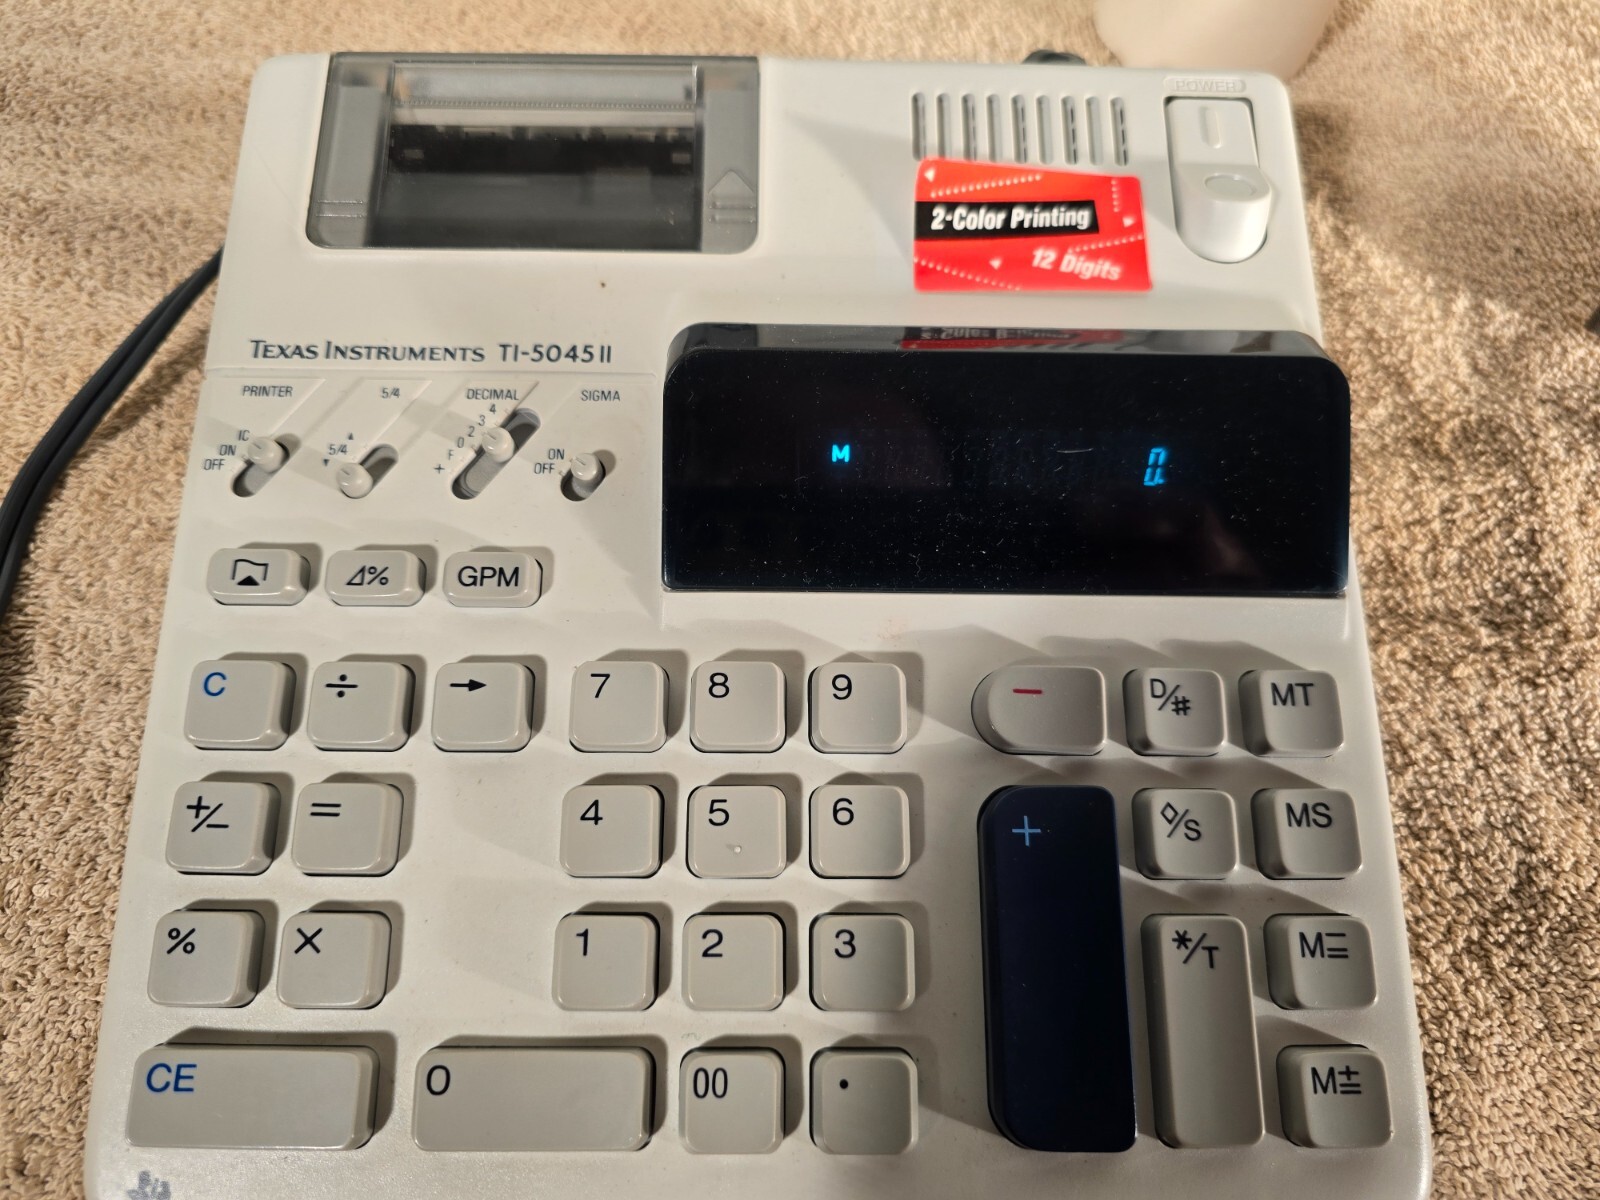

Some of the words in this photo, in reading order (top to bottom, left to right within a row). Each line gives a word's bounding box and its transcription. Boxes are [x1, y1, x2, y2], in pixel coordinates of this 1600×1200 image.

[1174, 79, 1237, 93] POWER
[930, 207, 1006, 231] 2-Color
[1009, 205, 1092, 230] Printing
[1031, 248, 1056, 269] 12
[1059, 251, 1122, 281] Digits
[242, 385, 293, 398] PRINTER
[381, 387, 401, 399] 5/4
[466, 388, 520, 401] DECIMAL
[581, 389, 621, 402] SIGMA
[479, 415, 487, 426] 3
[489, 404, 497, 415] 4
[238, 429, 251, 442] IC
[468, 426, 476, 437] 2
[219, 444, 237, 457] ON
[328, 443, 349, 456] 5/4
[447, 449, 455, 461] F
[547, 447, 566, 460] ON
[831, 444, 851, 463] M
[203, 458, 226, 471] OFF
[533, 462, 556, 475] OFF
[457, 565, 520, 588] GPM
[203, 671, 227, 697] C
[589, 672, 611, 699] 7
[708, 671, 731, 699] 8
[831, 673, 853, 701] 9
[1270, 682, 1314, 708] MT
[579, 799, 604, 826] 4
[707, 799, 730, 827] 5
[832, 797, 855, 826] 6
[1286, 801, 1333, 829] MS
[575, 928, 591, 957] 1
[701, 929, 724, 959] 2
[833, 929, 857, 959] 3
[145, 1062, 197, 1094] CE
[692, 1067, 729, 1100] 00
